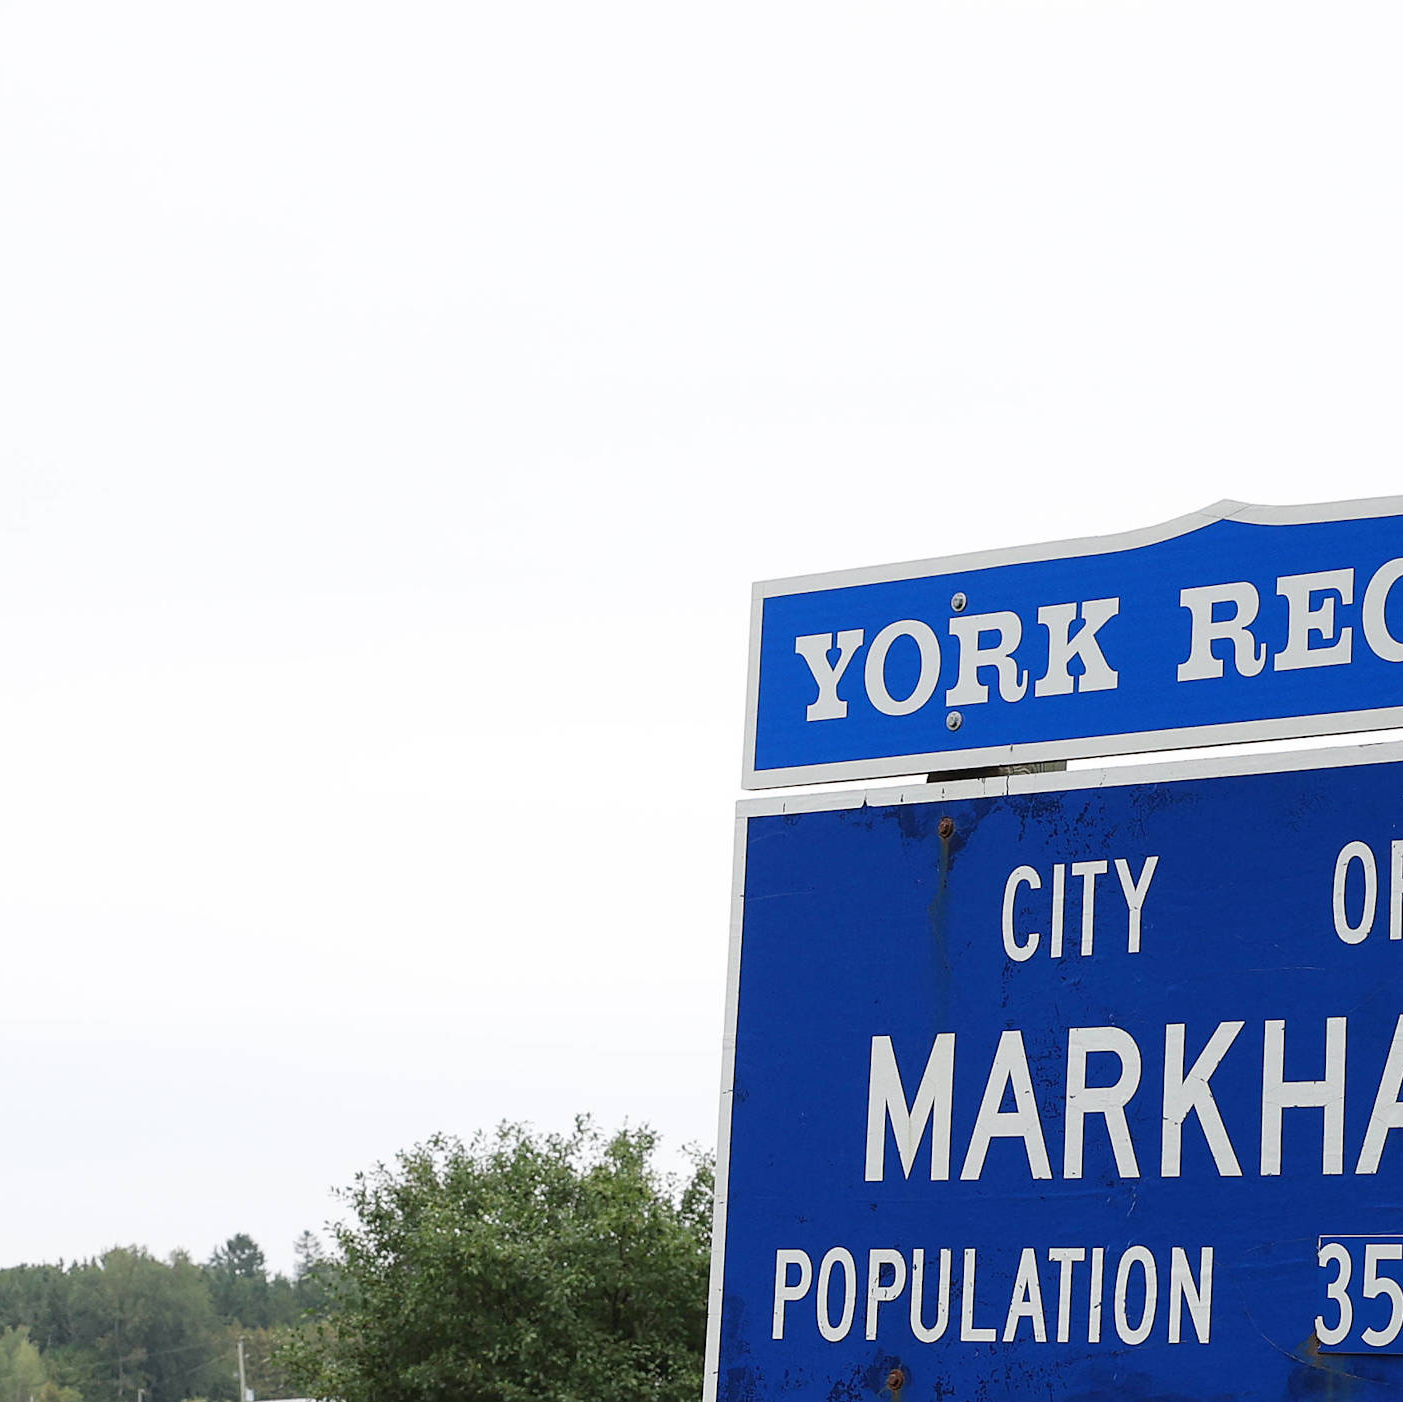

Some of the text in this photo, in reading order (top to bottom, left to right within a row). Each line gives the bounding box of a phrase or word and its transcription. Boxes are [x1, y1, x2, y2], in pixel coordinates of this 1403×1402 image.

[795, 597, 1120, 722] YORK
[1002, 855, 1159, 962] CITY
[772, 1245, 1214, 1345] POPULATION
